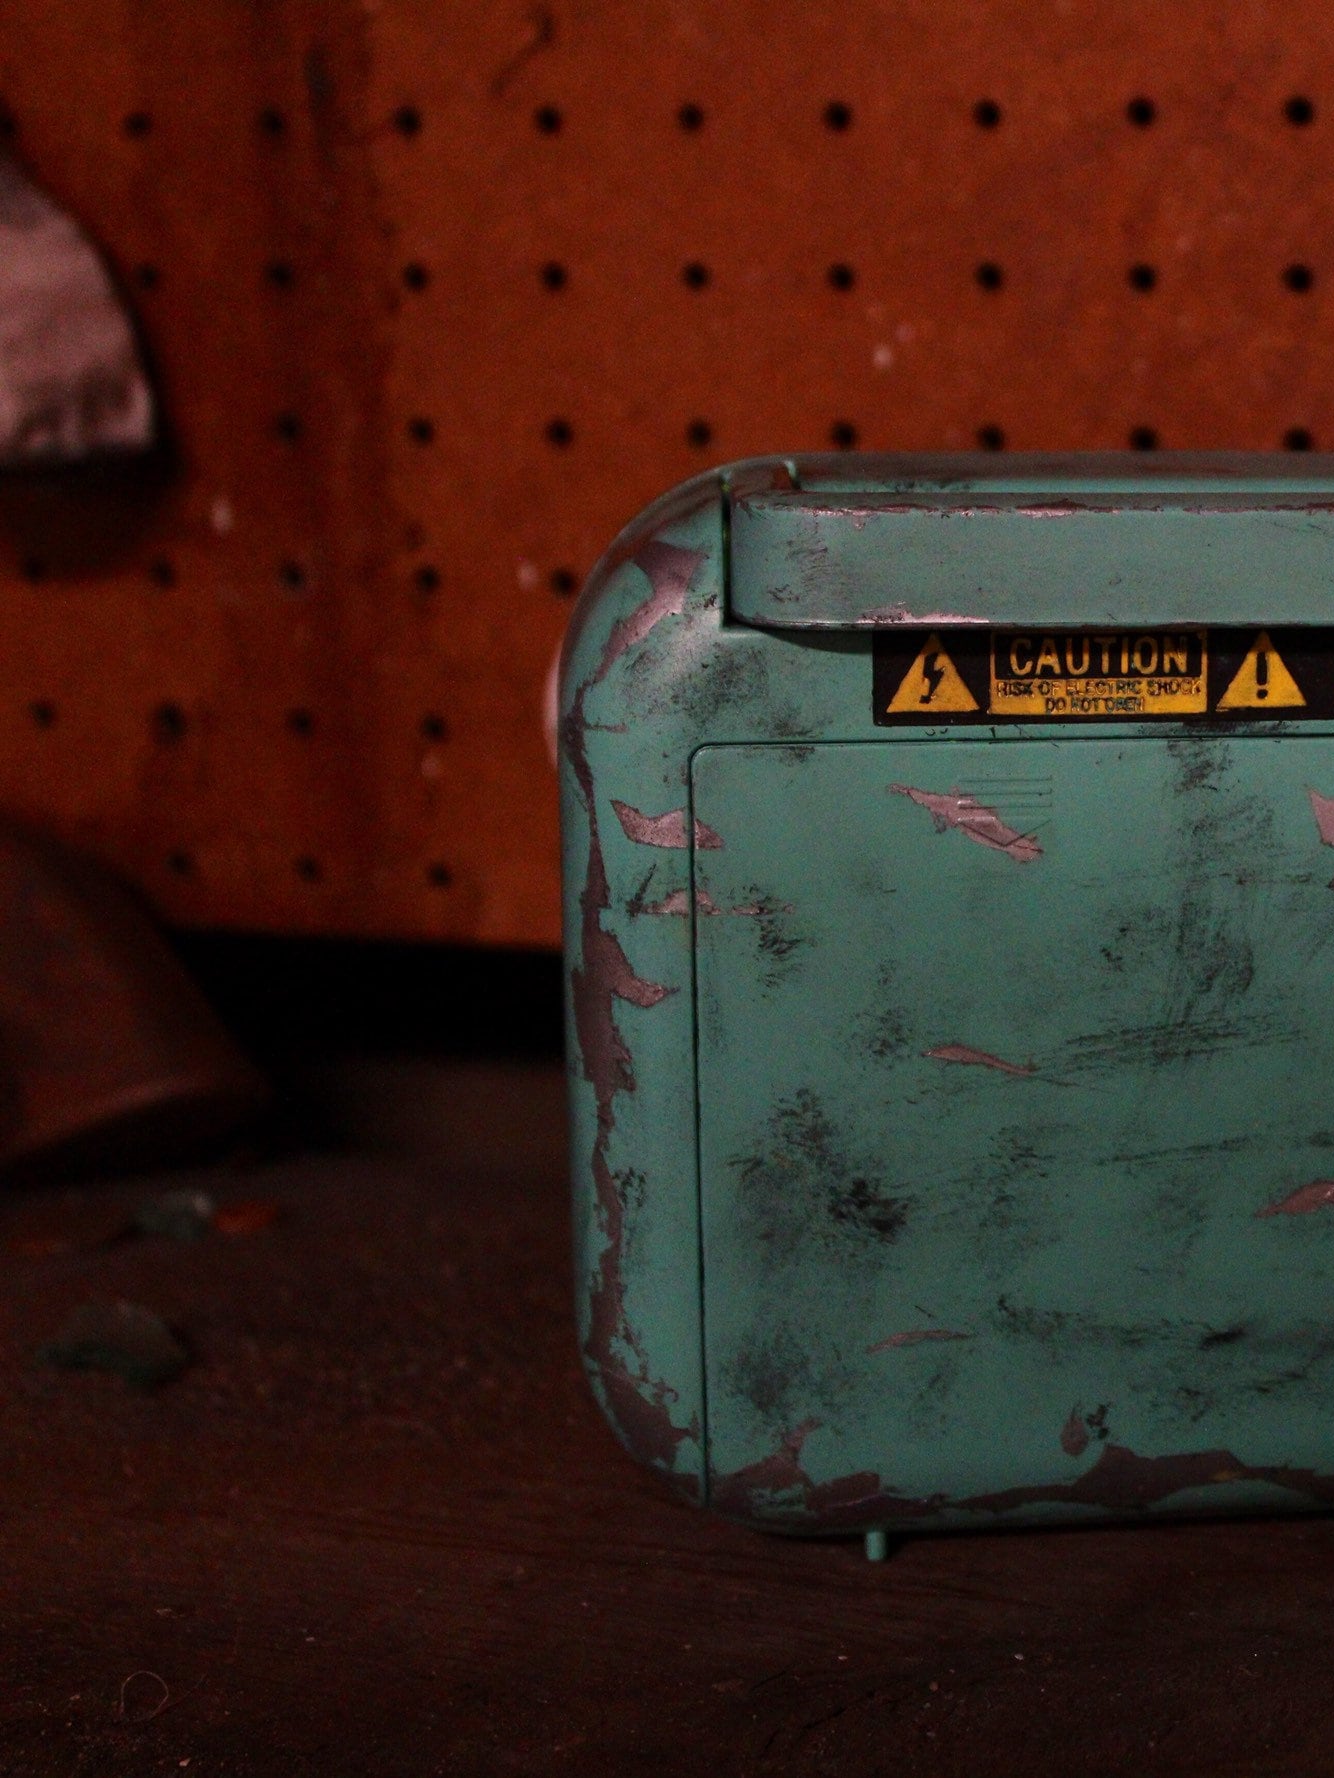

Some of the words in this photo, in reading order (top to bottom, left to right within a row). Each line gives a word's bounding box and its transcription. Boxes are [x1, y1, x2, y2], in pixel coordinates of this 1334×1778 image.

[1009, 636, 1188, 675] CAUTION
[996, 681, 1035, 698] RISK
[1038, 681, 1061, 695] OF
[1066, 680, 1141, 697] ELECTRIC
[1146, 679, 1201, 696] SHOCK
[1045, 697, 1066, 713] DO
[1071, 697, 1103, 712] NOT
